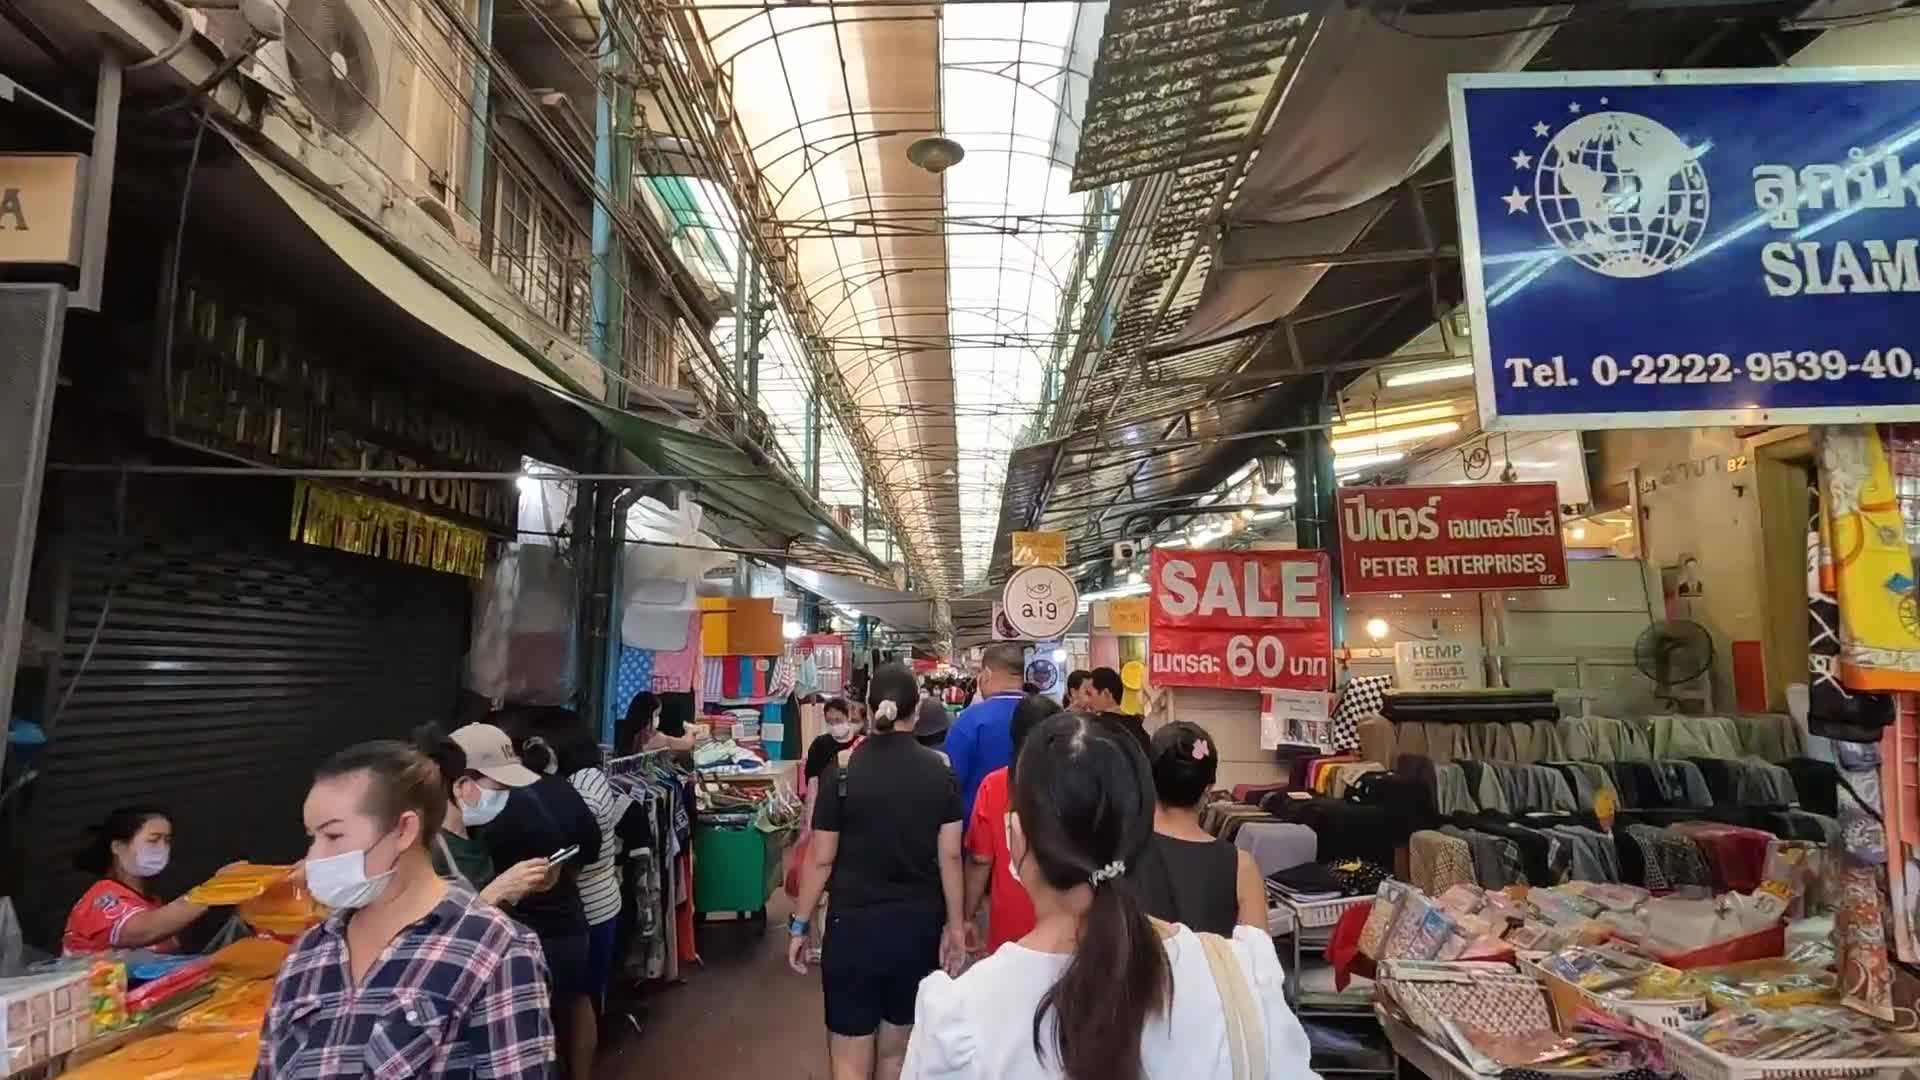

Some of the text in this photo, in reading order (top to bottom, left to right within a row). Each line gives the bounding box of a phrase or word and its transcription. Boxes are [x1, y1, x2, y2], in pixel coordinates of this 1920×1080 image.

[1761, 239, 1920, 296] SIAM
[1505, 356, 1579, 387] Tel.
[1344, 494, 1442, 541] ปีเตอร์
[1359, 553, 1547, 578] PETER ENTERPRISES
[1158, 559, 1321, 617] SALE
[1021, 600, 1058, 620] aig
[1152, 634, 1328, 678] เมตรละ 60 บาท
[1412, 644, 1462, 659] HEMP
